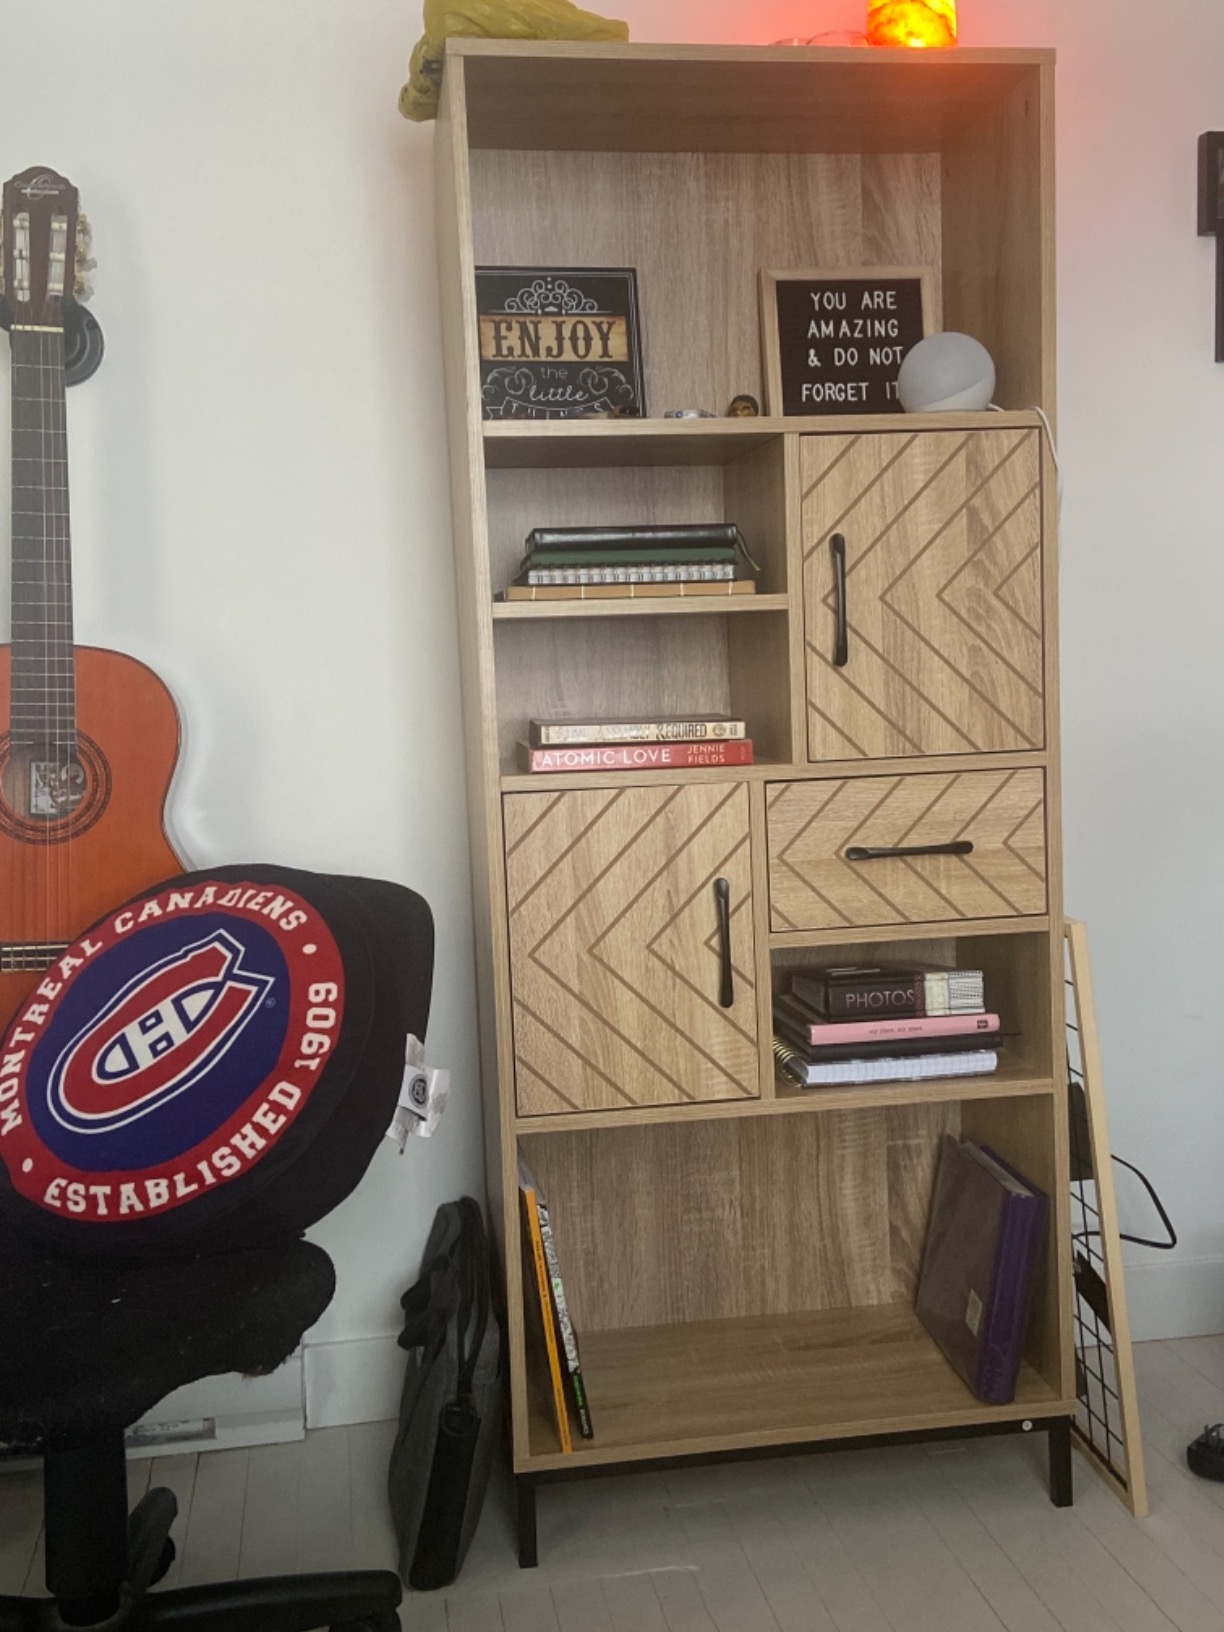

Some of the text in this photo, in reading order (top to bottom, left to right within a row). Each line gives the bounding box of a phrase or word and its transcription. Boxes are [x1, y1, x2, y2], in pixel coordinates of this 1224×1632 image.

[810, 291, 897, 311] YOU ARE
[808, 319, 899, 339] AMAZING
[490, 319, 617, 360] ENJOY
[808, 346, 904, 367] & DO NOT
[541, 367, 568, 380] the
[529, 385, 589, 401] little
[802, 381, 869, 402] FORGET
[656, 723, 707, 740] REQUIRED
[542, 747, 671, 767] ATOMIC LOVE
[687, 743, 725, 754] JENNIE
[688, 754, 725, 765] FIELDS
[845, 989, 915, 1009] PHOTOS
[0, 886, 307, 1136] MONTREAL CANADIENS
[44, 982, 339, 1215] ESTABLISHED 1909
